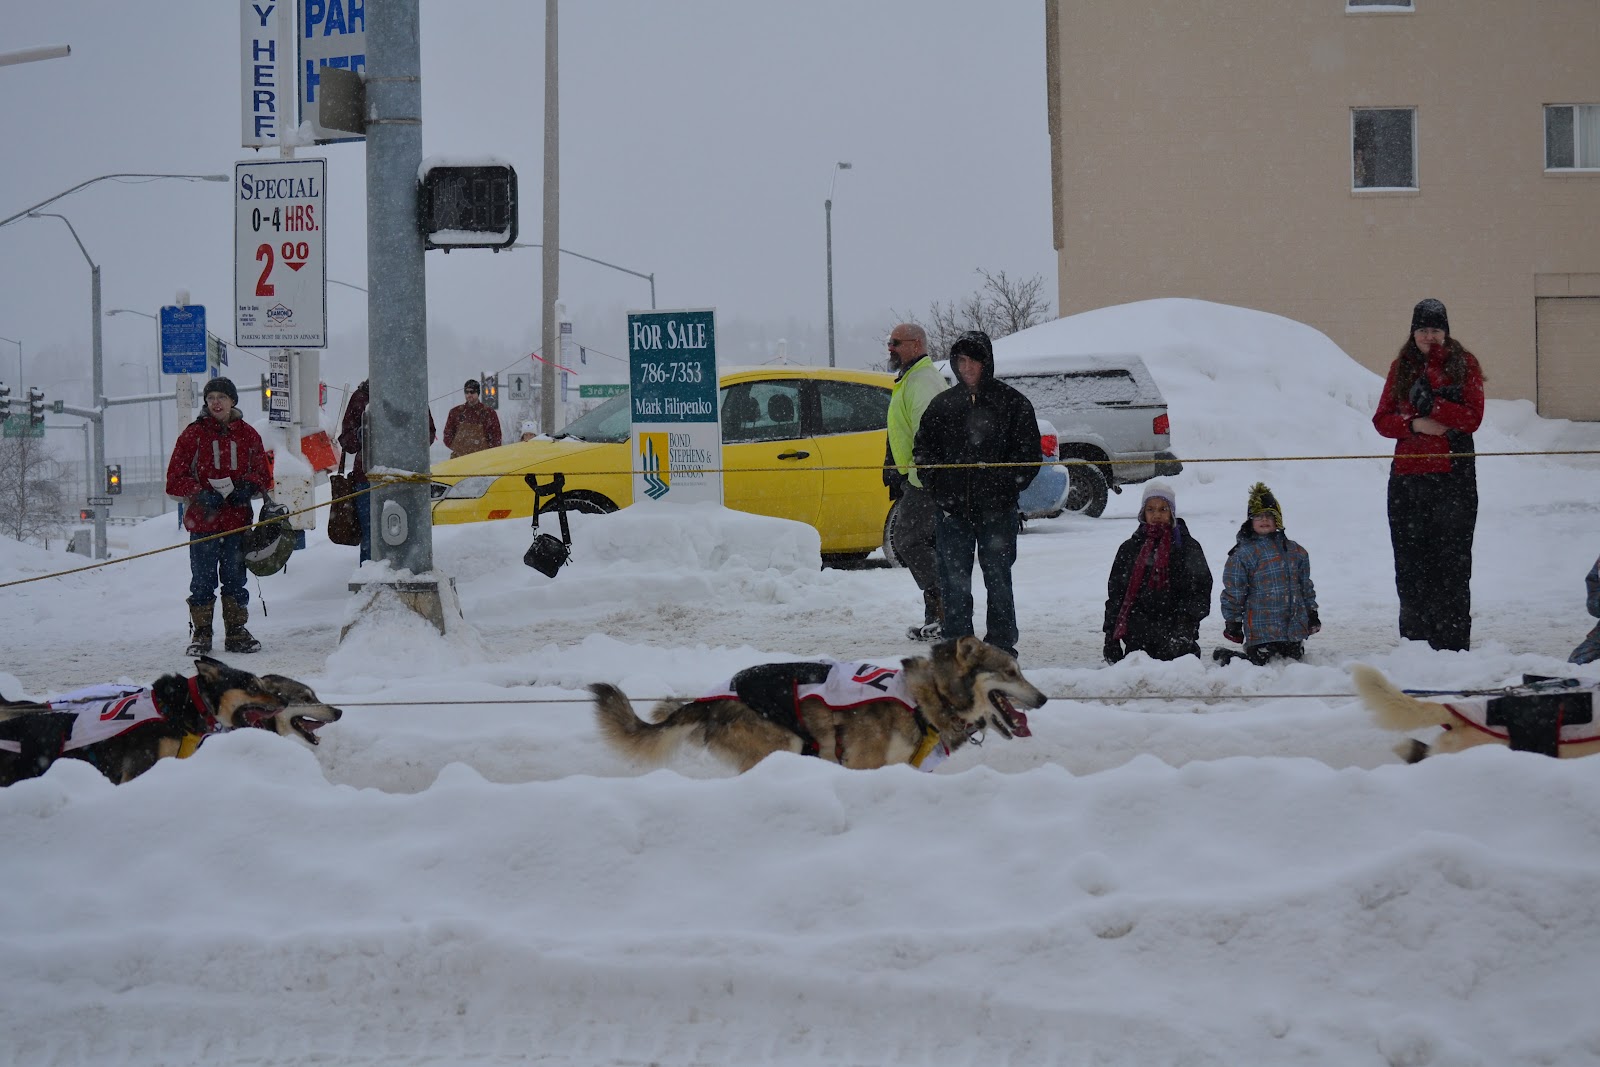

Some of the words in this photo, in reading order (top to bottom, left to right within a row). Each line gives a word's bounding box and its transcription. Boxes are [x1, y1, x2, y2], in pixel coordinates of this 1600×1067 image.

[305, 0, 365, 38] PAR
[241, 173, 319, 200] SPECIAL
[252, 206, 281, 232] 0-4
[285, 204, 319, 232] HRS.
[255, 243, 275, 296] 2
[632, 322, 663, 350] FOR
[667, 320, 707, 349] SALE
[641, 361, 702, 384] 786-7353
[636, 398, 663, 416] Mark
[664, 397, 712, 420] Filipenko
[669, 447, 705, 463] STEPHENS
